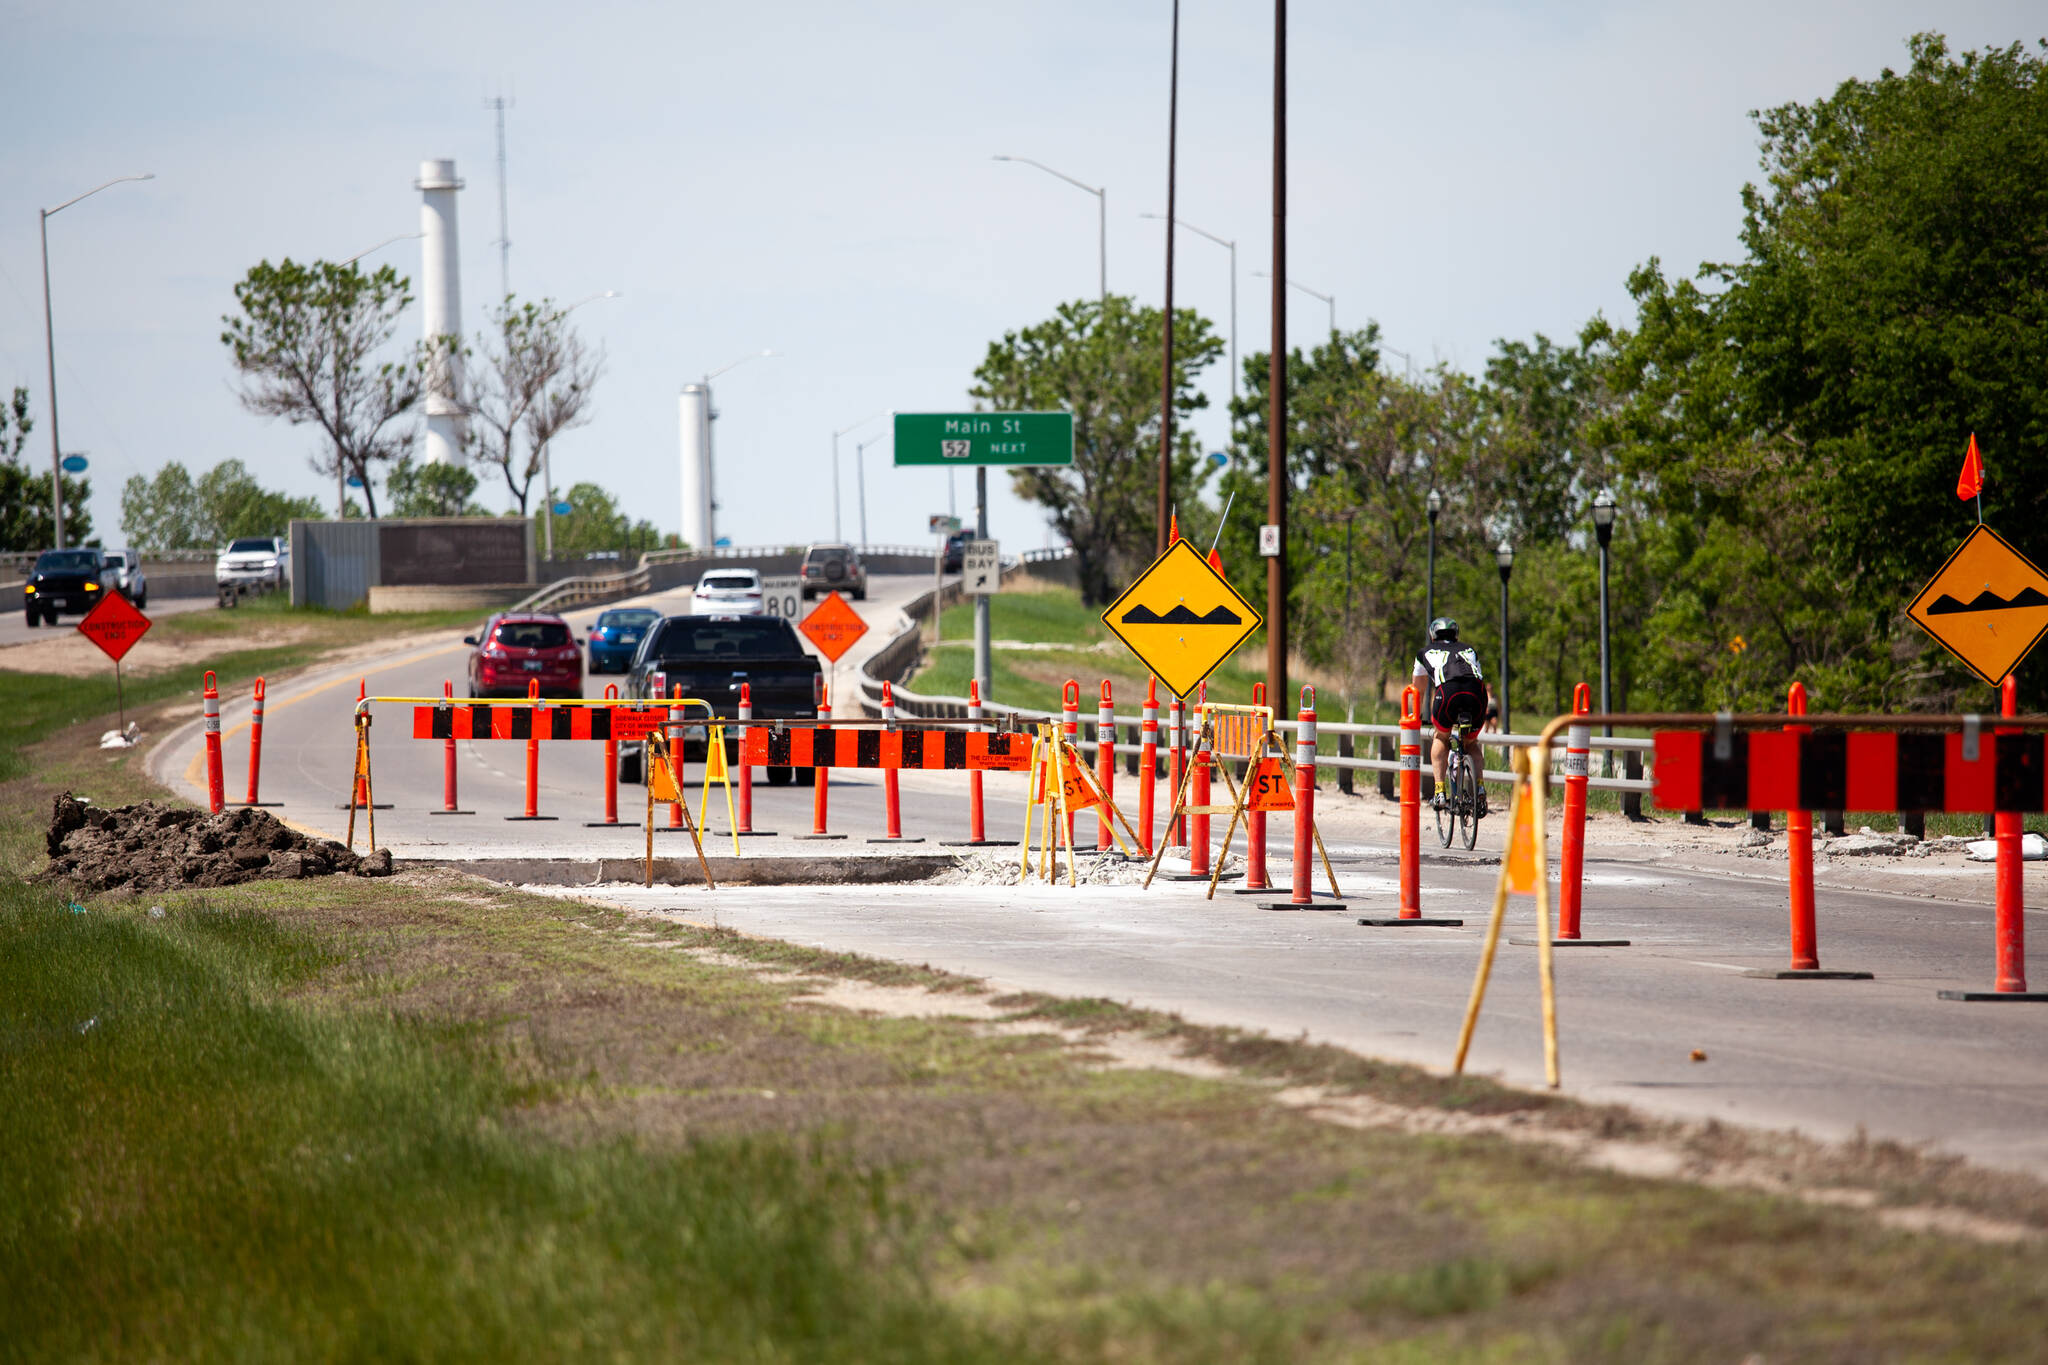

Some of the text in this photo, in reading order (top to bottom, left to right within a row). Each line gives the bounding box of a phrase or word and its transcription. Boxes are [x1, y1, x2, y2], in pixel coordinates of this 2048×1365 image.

[944, 419, 1021, 433] Main St
[947, 441, 1027, 457] 52 NEXT
[967, 544, 995, 555] BUS
[967, 560, 994, 569] BAY
[768, 596, 797, 618] 80
[84, 621, 146, 632] CONSTRUCTION
[104, 631, 127, 640] ENDS
[1259, 775, 1282, 794] ST
